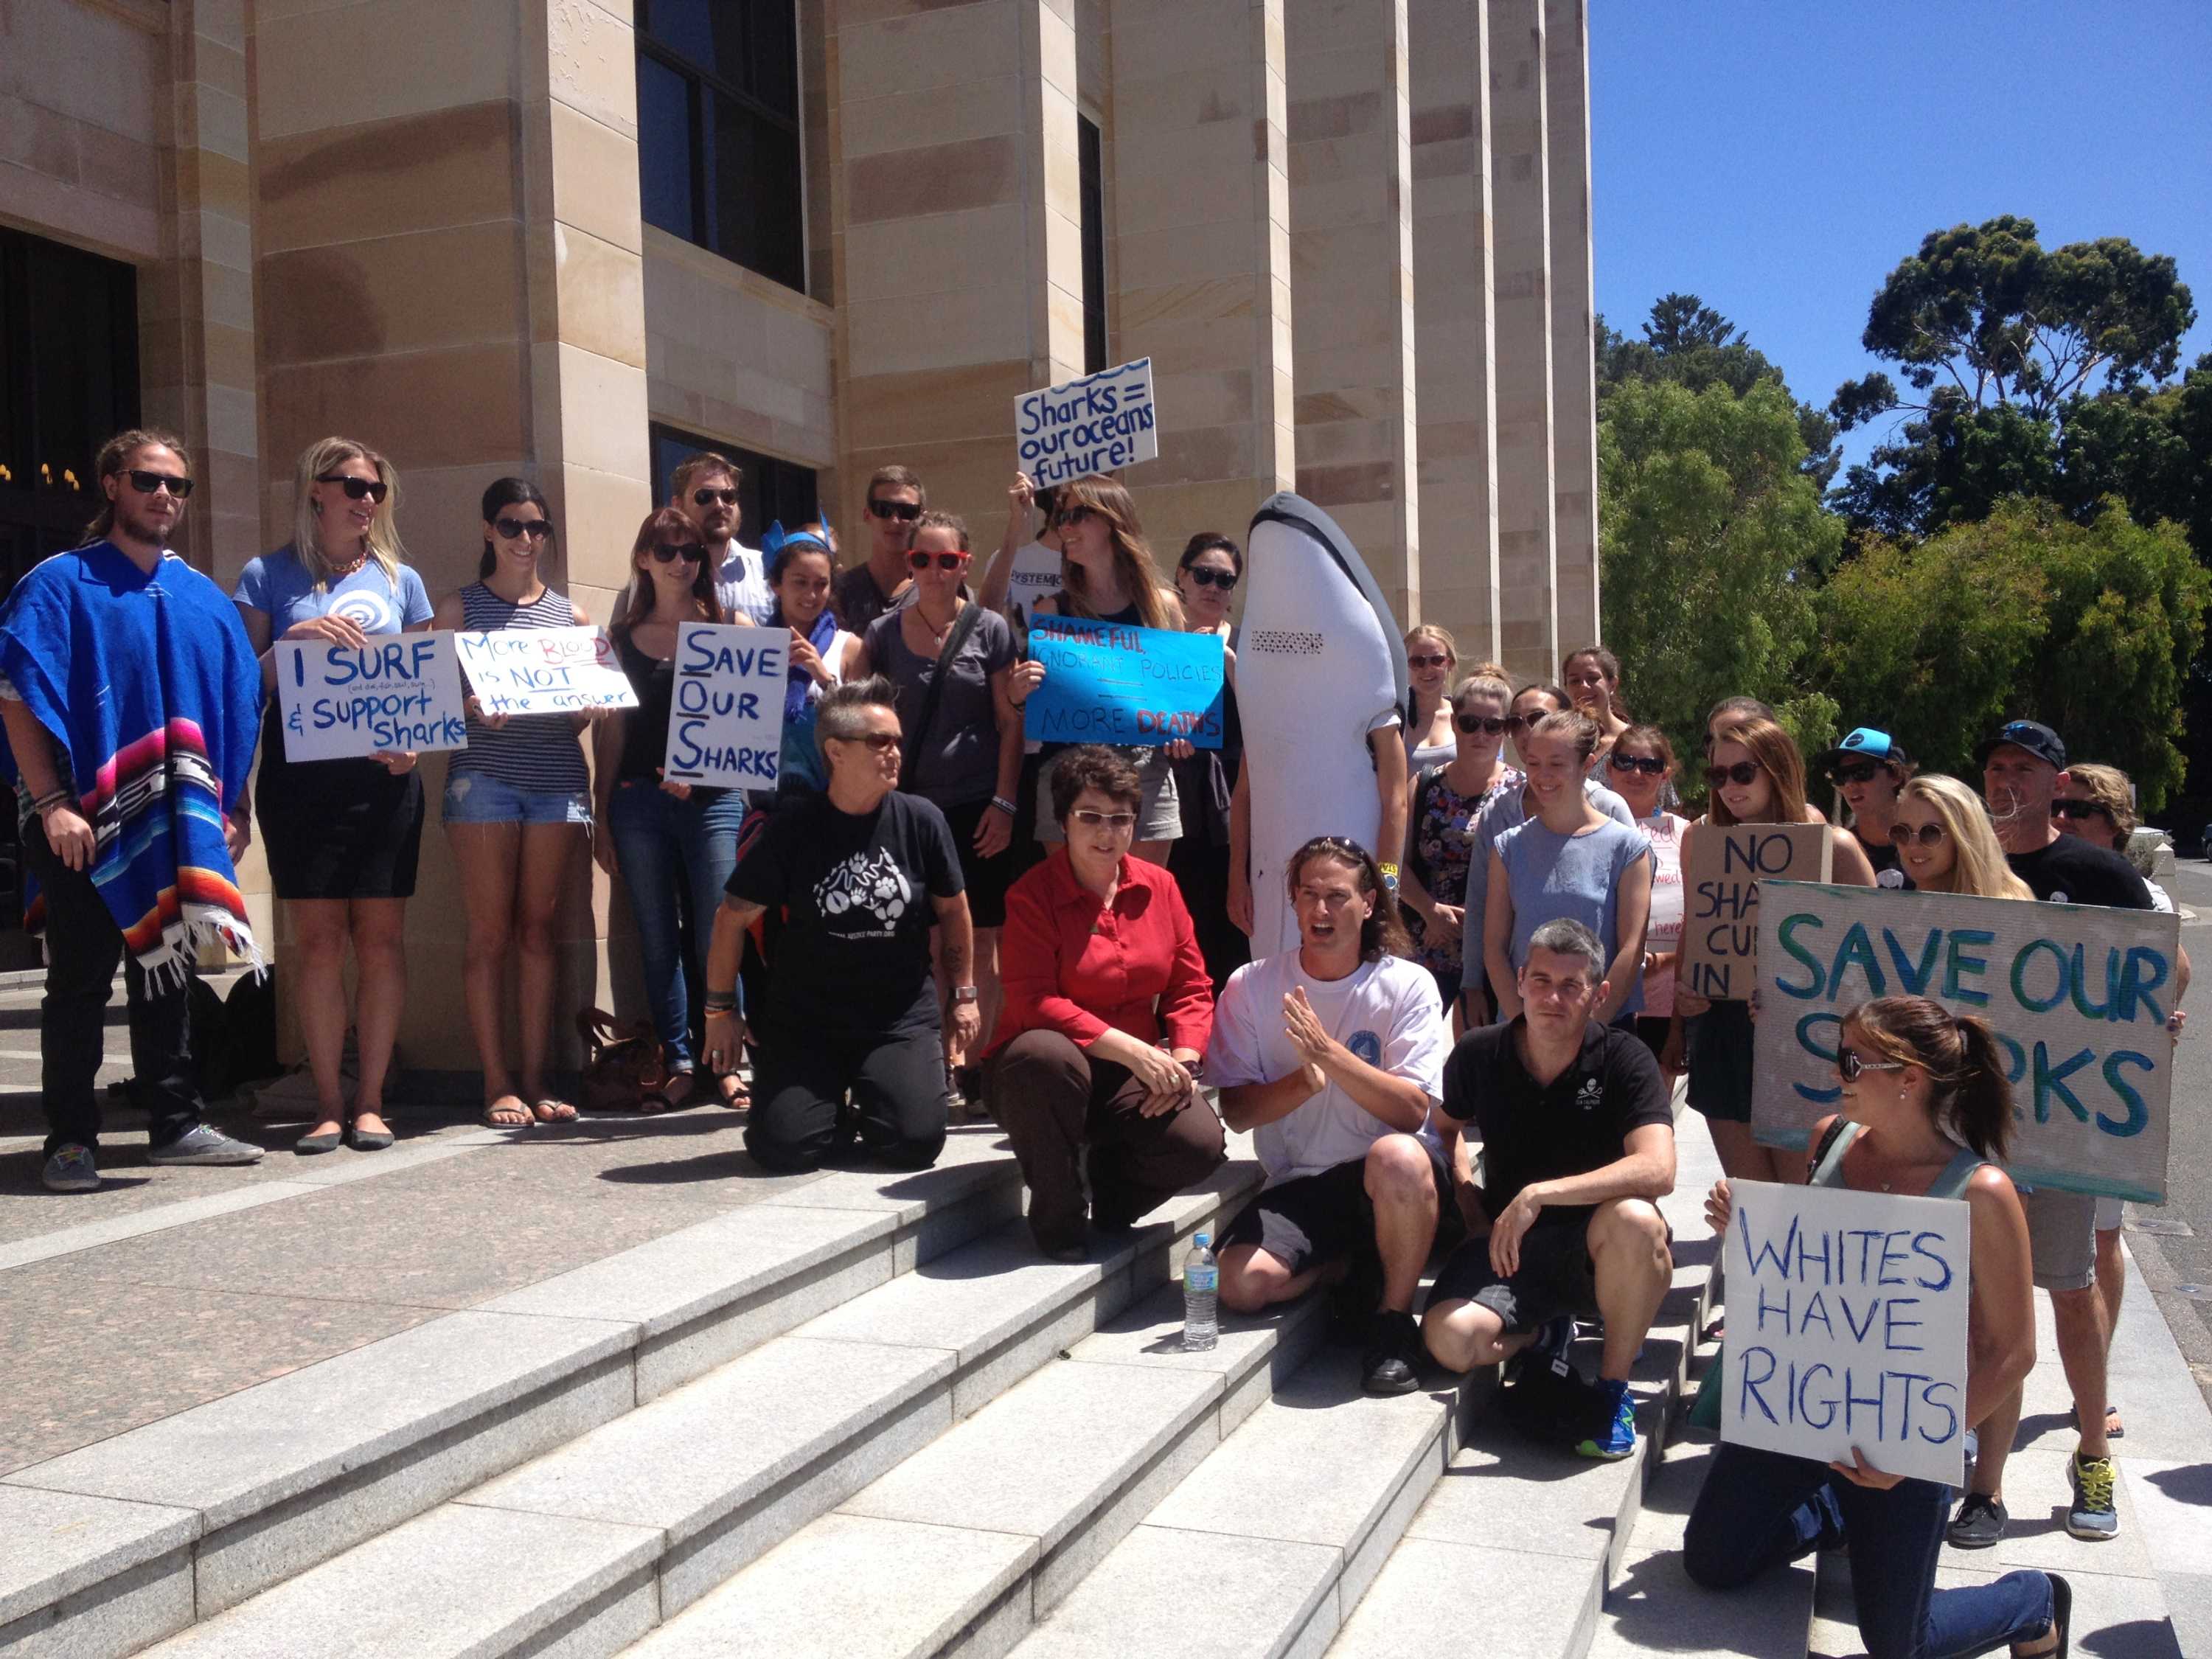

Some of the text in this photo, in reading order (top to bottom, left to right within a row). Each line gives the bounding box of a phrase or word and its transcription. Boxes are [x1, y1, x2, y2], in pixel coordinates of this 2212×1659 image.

[1020, 386, 1117, 435] Sharks
[1020, 403, 1154, 460] our oceans
[1032, 437, 1134, 487] future!
[294, 639, 436, 687] I SURF
[462, 635, 530, 661] More
[510, 667, 571, 688] NOT
[1141, 659, 1222, 682] POLICIES
[313, 687, 432, 730] Support
[490, 692, 627, 711] the answer
[1041, 707, 1221, 737] MORE DEATHS
[373, 711, 466, 749] Sharks
[1725, 834, 1792, 874] NO
[1696, 882, 1759, 920] SHA
[1693, 962, 1730, 998] IN
[1775, 913, 2168, 1025] SAVE OUR
[1739, 1207, 1953, 1292] WHITES
[1759, 1284, 1924, 1350] HAVE
[1739, 1346, 1958, 1444] RIGHTS
